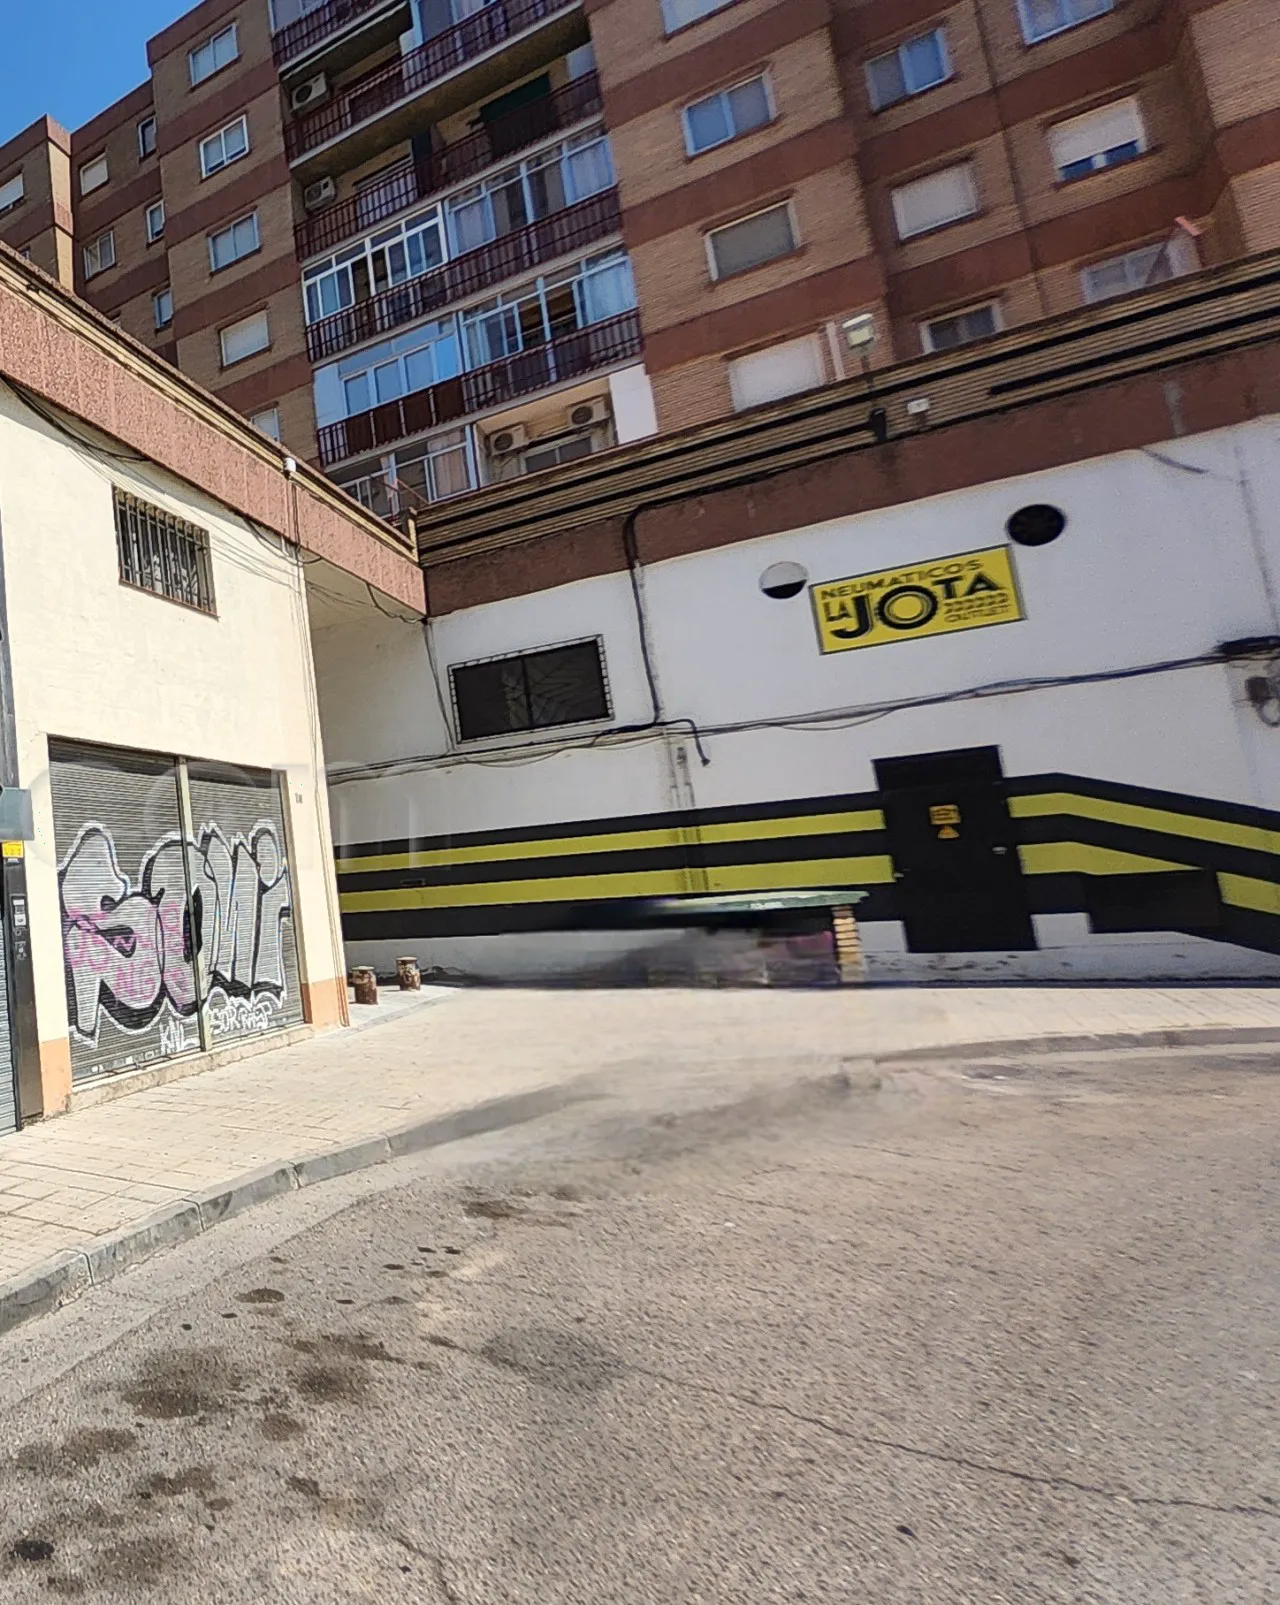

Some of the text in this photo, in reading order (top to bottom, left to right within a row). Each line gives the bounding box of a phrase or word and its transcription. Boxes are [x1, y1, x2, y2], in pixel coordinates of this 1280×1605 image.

[820, 558, 984, 600] NEUMATICOS
[822, 571, 1000, 640] LA JOTA
